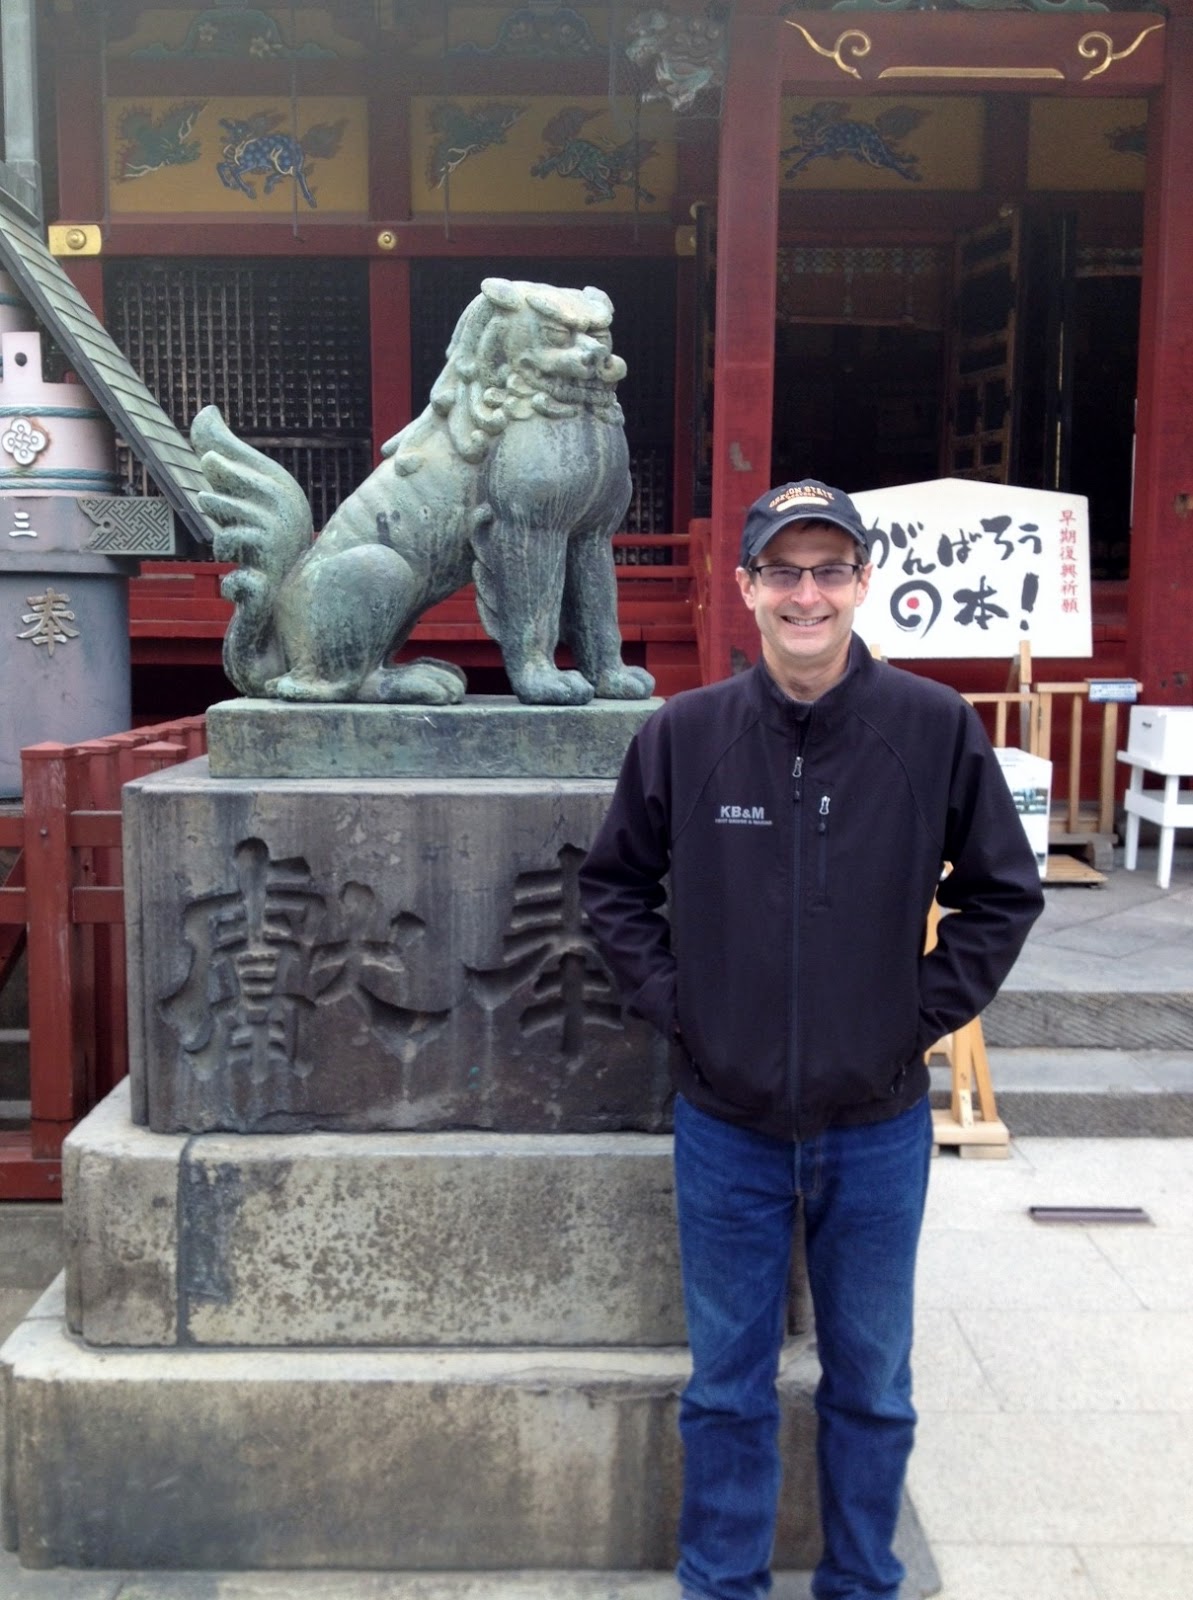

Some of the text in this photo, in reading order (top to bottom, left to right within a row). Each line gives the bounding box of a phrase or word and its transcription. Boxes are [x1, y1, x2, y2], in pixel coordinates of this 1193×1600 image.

[867, 515, 1042, 576] がんばろう
[1058, 509, 1080, 614] 早期復興祈願
[16, 587, 80, 657] 奉
[720, 805, 765, 820] KB&M
